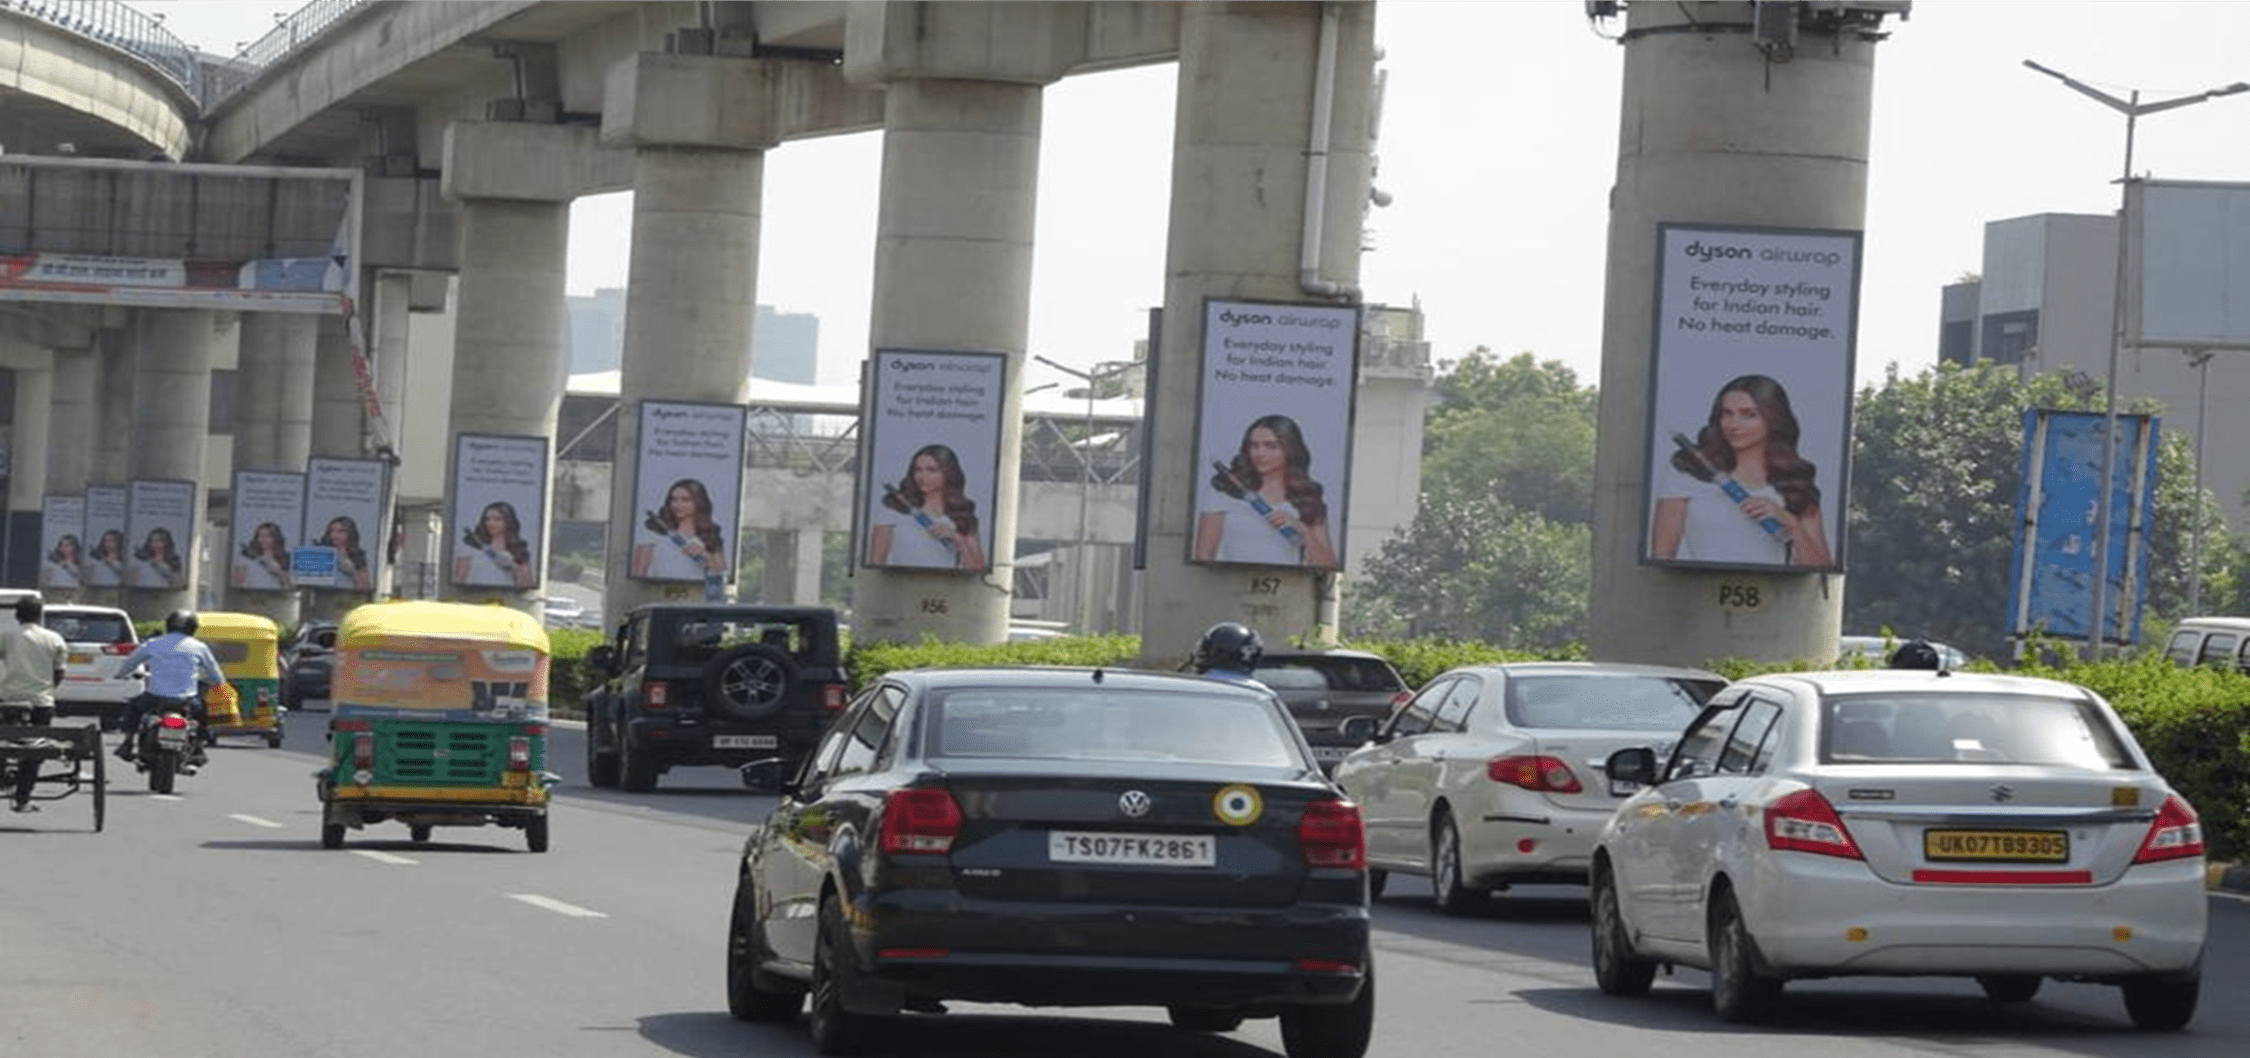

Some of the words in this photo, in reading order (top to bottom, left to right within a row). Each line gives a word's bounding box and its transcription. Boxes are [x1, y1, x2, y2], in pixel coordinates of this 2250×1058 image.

[1685, 240, 1752, 263] dyson
[1760, 247, 1841, 267] airwrap
[1690, 276, 1769, 297] Everyday
[1774, 281, 1831, 300] styling
[1693, 297, 1719, 312] for
[1724, 299, 1780, 315] Indian
[1785, 302, 1823, 317] hair.
[1220, 310, 1272, 327] dyson
[1678, 316, 1706, 332] No
[1711, 318, 1752, 333] heat
[1755, 319, 1835, 340] damage.
[1224, 338, 1286, 353] Everyday
[1215, 369, 1237, 381] No
[1240, 370, 1271, 382] heat
[1251, 577, 1281, 595] P57
[1720, 584, 1760, 607] P58
[1063, 836, 1208, 859] TS07FK2861
[1939, 835, 2066, 855] UK07TB9305
